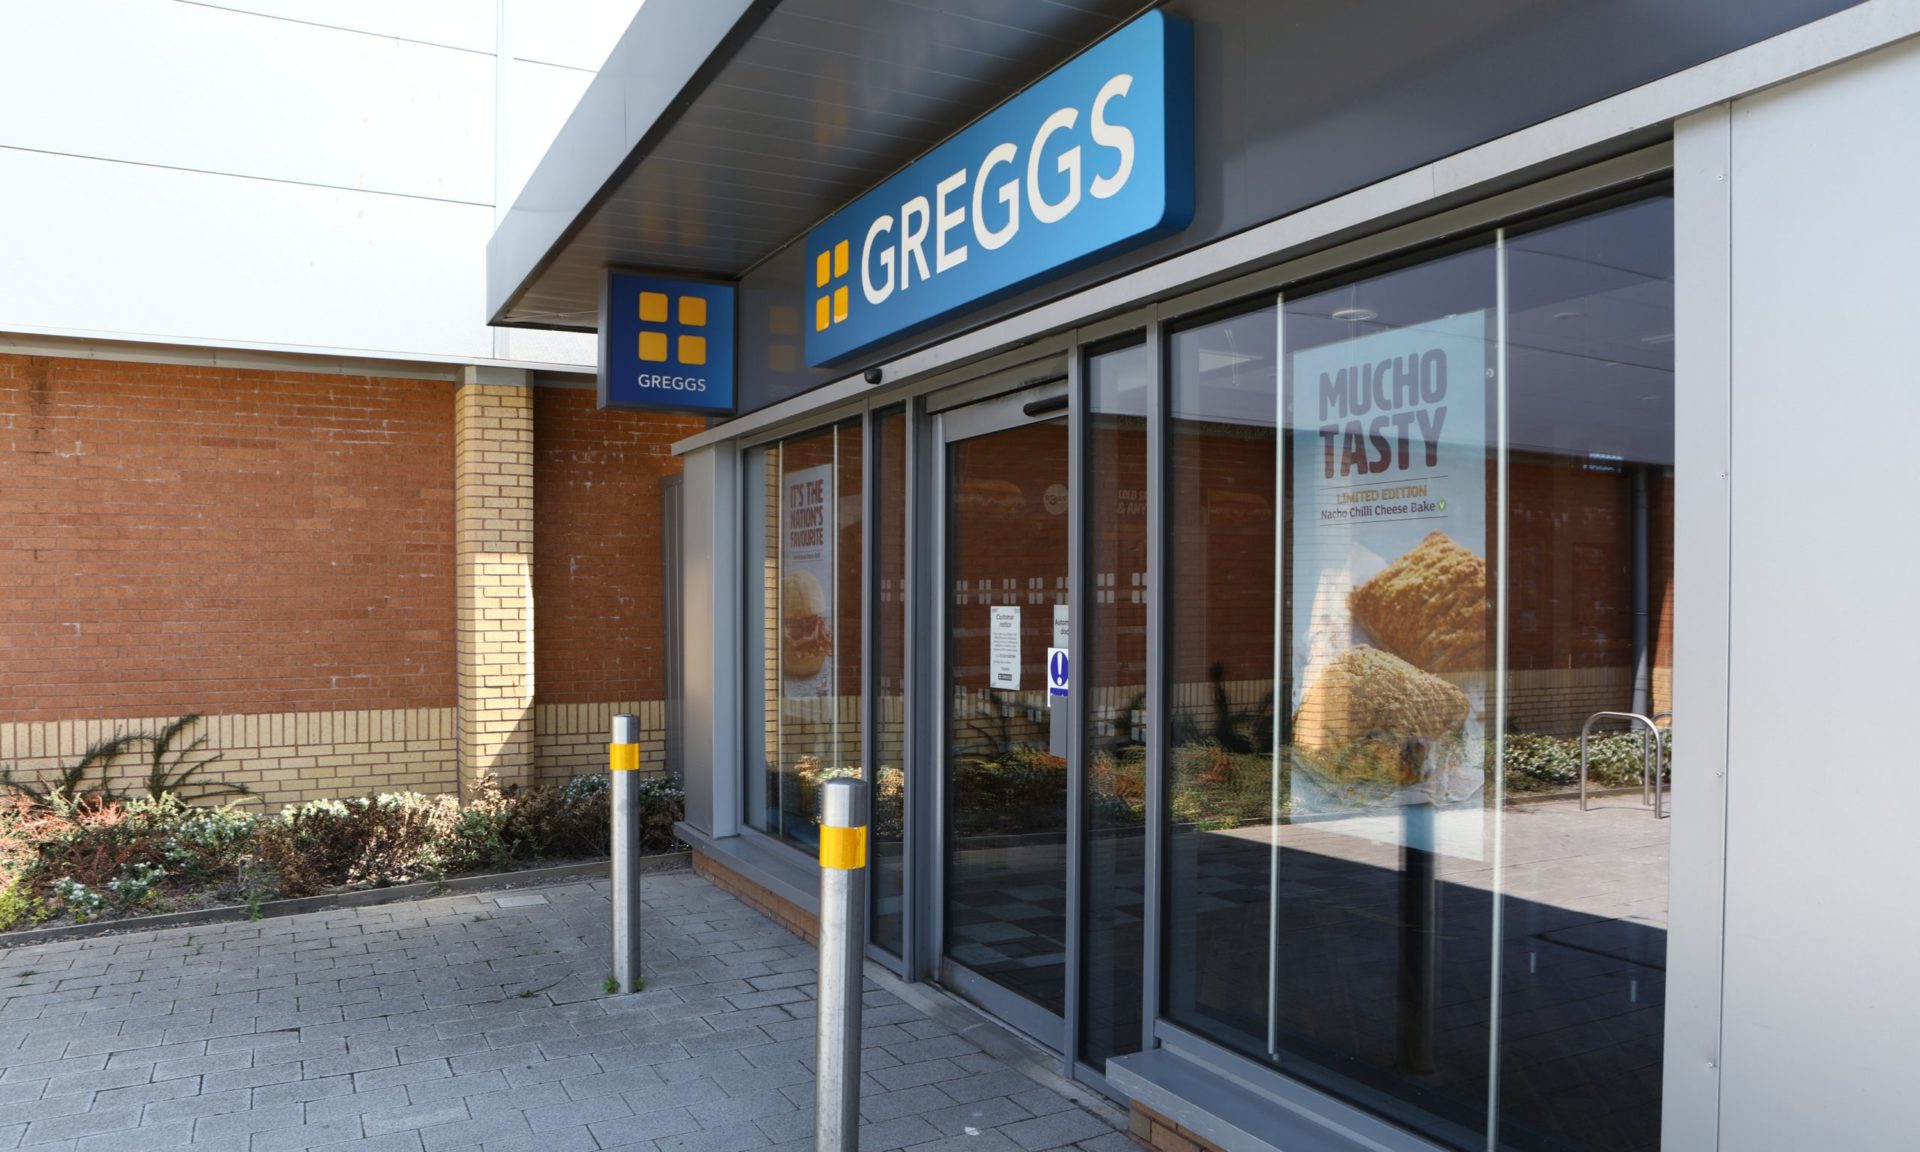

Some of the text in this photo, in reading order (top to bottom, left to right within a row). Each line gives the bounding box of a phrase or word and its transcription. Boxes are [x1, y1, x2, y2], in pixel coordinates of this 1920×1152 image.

[861, 73, 1135, 304] GREGGS
[638, 374, 706, 392] GREGGS
[1319, 348, 1447, 421] MUCHO
[1319, 406, 1447, 479] TASTY
[791, 479, 824, 508] IT'S THE
[1337, 484, 1428, 505] LIMITED EDITION
[791, 506, 824, 530] NATION'S
[1321, 509, 1348, 521] Nacho
[1349, 504, 1373, 518] Chilli
[1374, 503, 1408, 516] Cheese
[1411, 500, 1436, 513] Bake
[791, 528, 824, 549] FAVOURITE
